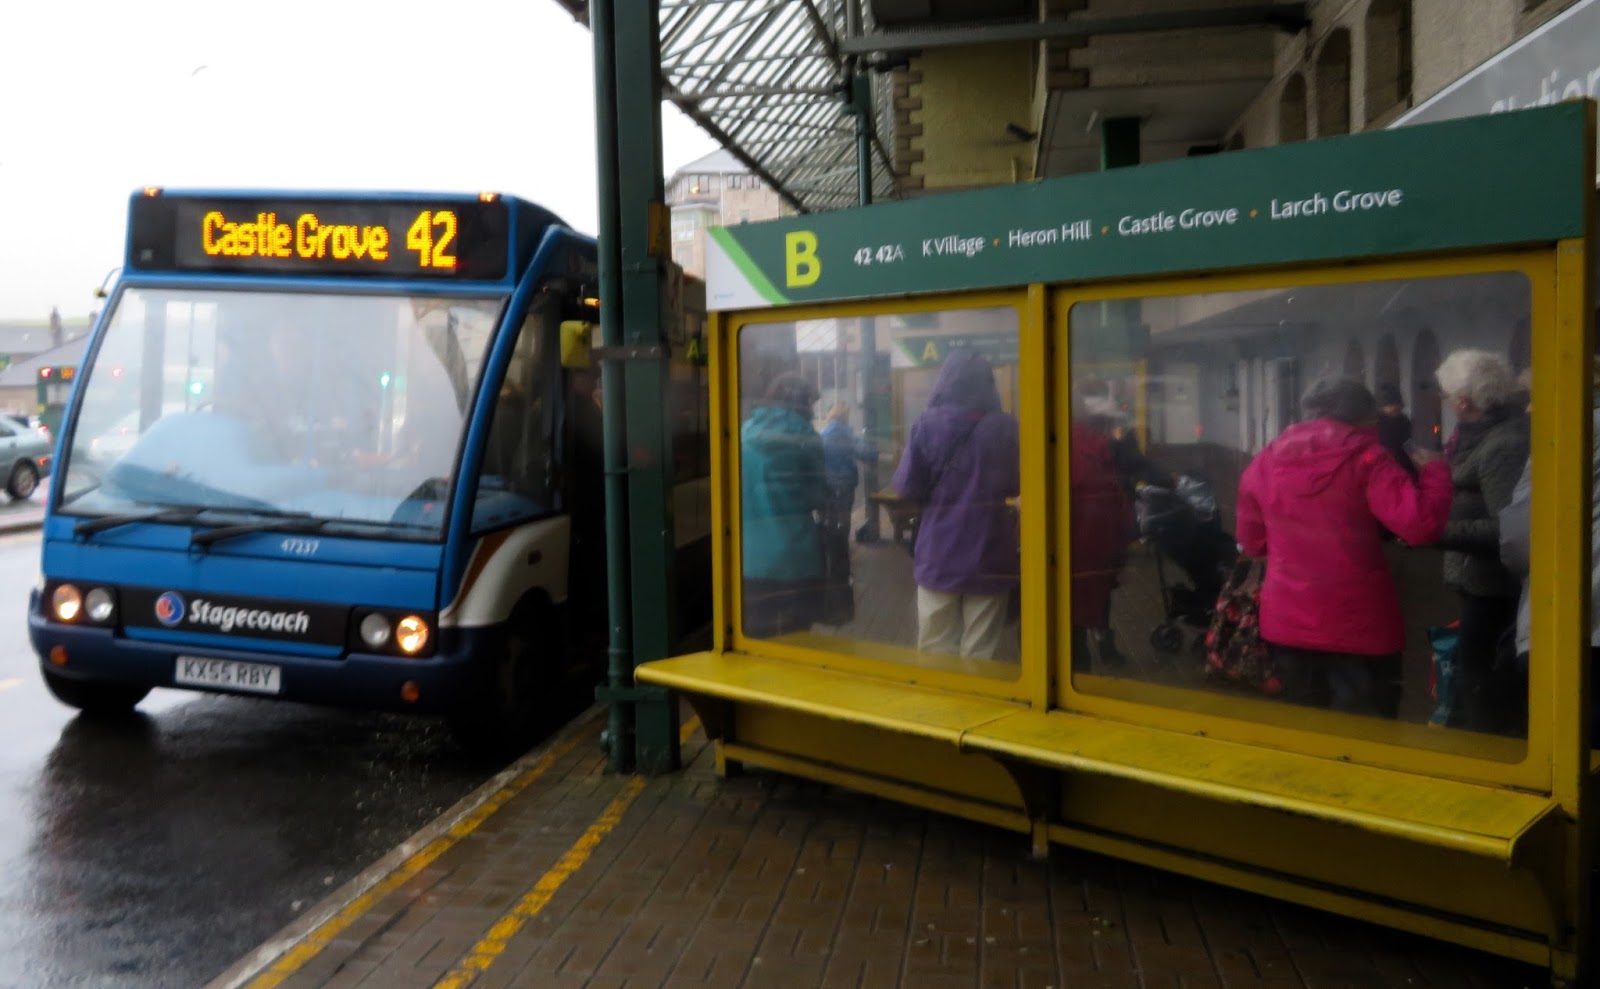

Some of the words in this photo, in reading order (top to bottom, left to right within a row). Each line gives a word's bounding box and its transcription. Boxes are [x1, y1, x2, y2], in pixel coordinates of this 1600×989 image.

[203, 211, 292, 257] Castle
[296, 213, 389, 260] Grove
[407, 210, 457, 267] 42
[853, 247, 872, 265] 42
[875, 244, 904, 264] 42A
[922, 238, 933, 257] K
[935, 236, 985, 256] Village
[1008, 228, 1056, 247] Heron
[1062, 220, 1092, 241] Hill
[1117, 211, 1175, 236] Castle
[1179, 206, 1239, 229] Grove
[1271, 193, 1328, 219] Larch
[1333, 188, 1403, 212] Grove
[785, 230, 821, 288] B
[922, 341, 939, 361] A
[189, 599, 309, 633] Stagecoach
[235, 665, 272, 686] RBY
